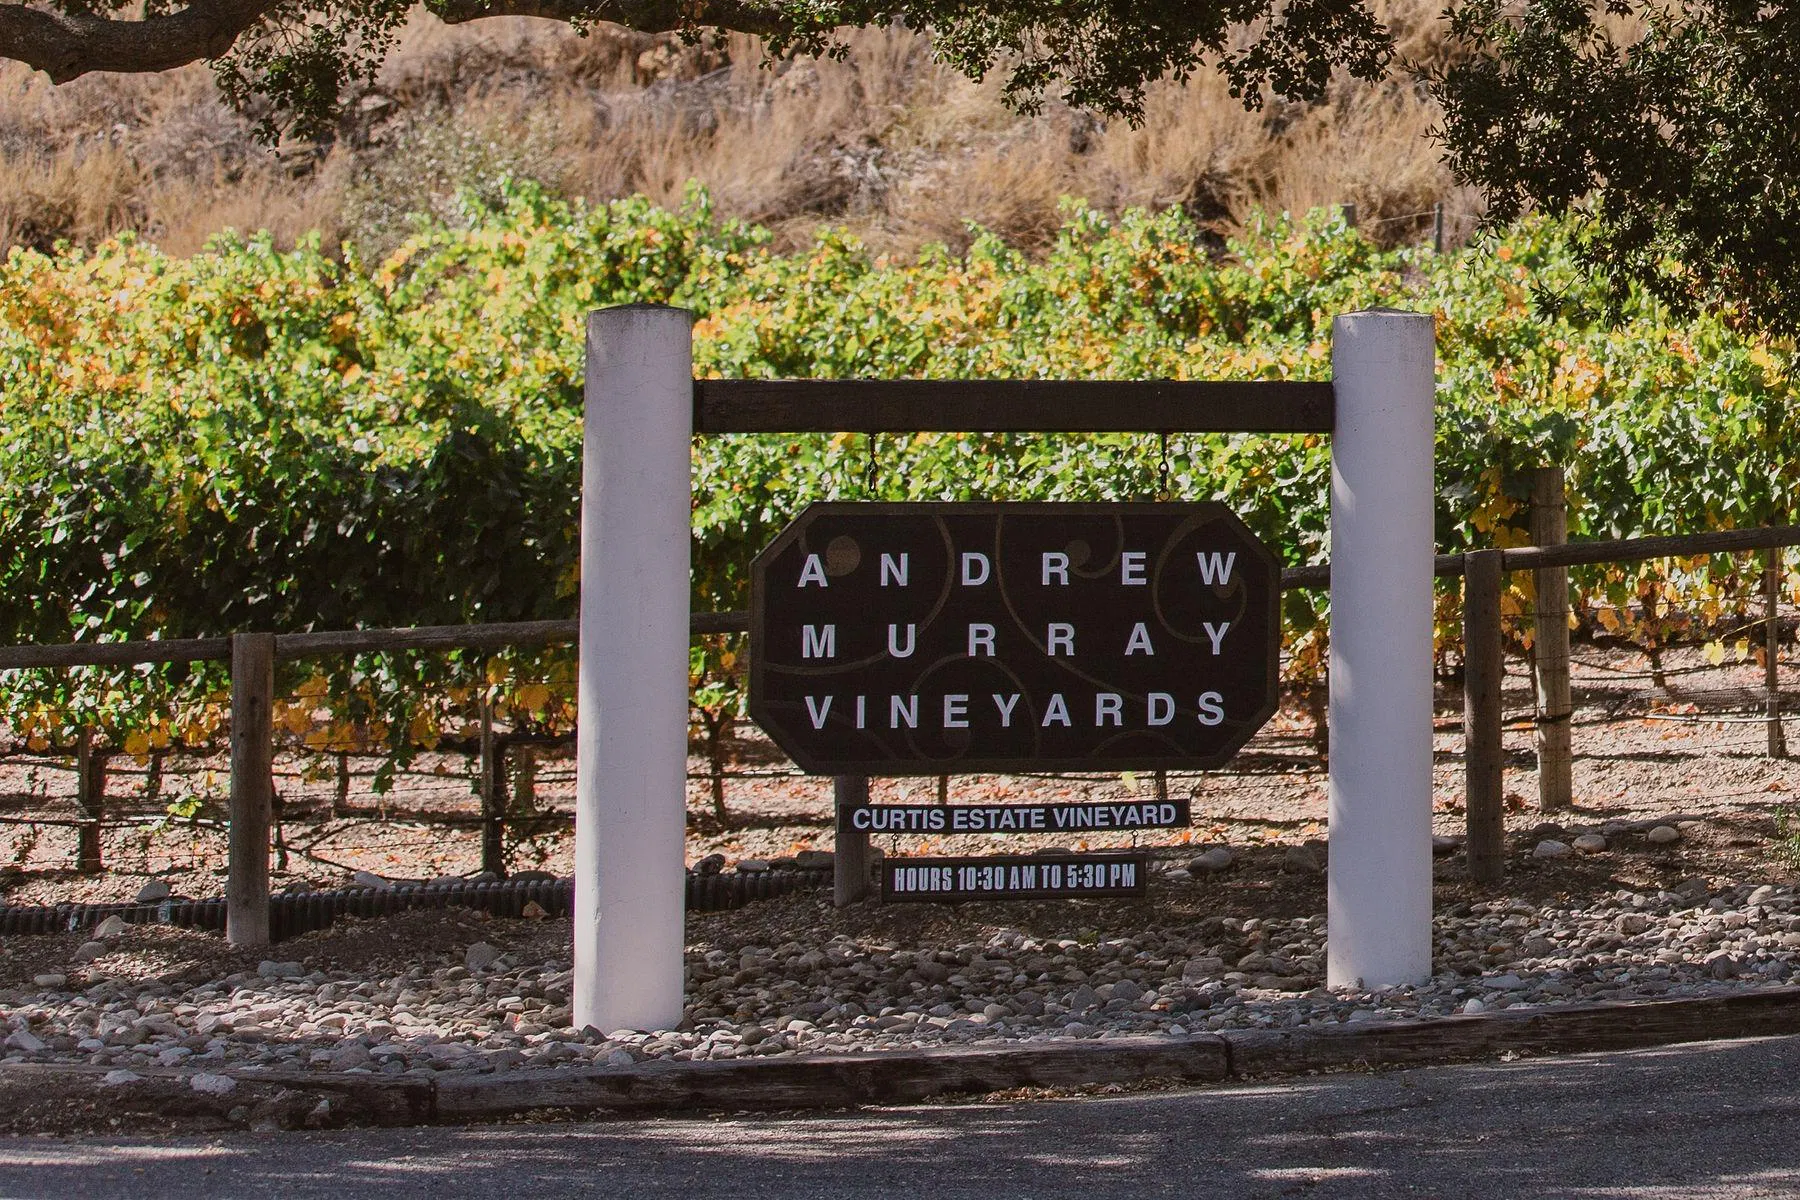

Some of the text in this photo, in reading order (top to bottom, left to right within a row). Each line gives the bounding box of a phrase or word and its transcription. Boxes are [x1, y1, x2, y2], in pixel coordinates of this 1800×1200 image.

[797, 552, 1236, 588] ANDREW
[801, 621, 1231, 659] MURRAY
[804, 690, 1226, 730] VINEYARDS
[852, 804, 1176, 830] CURTIS ESTATE VINEYARD
[894, 863, 1136, 892] HOURS 10:30 AM TO 5:30 PM
